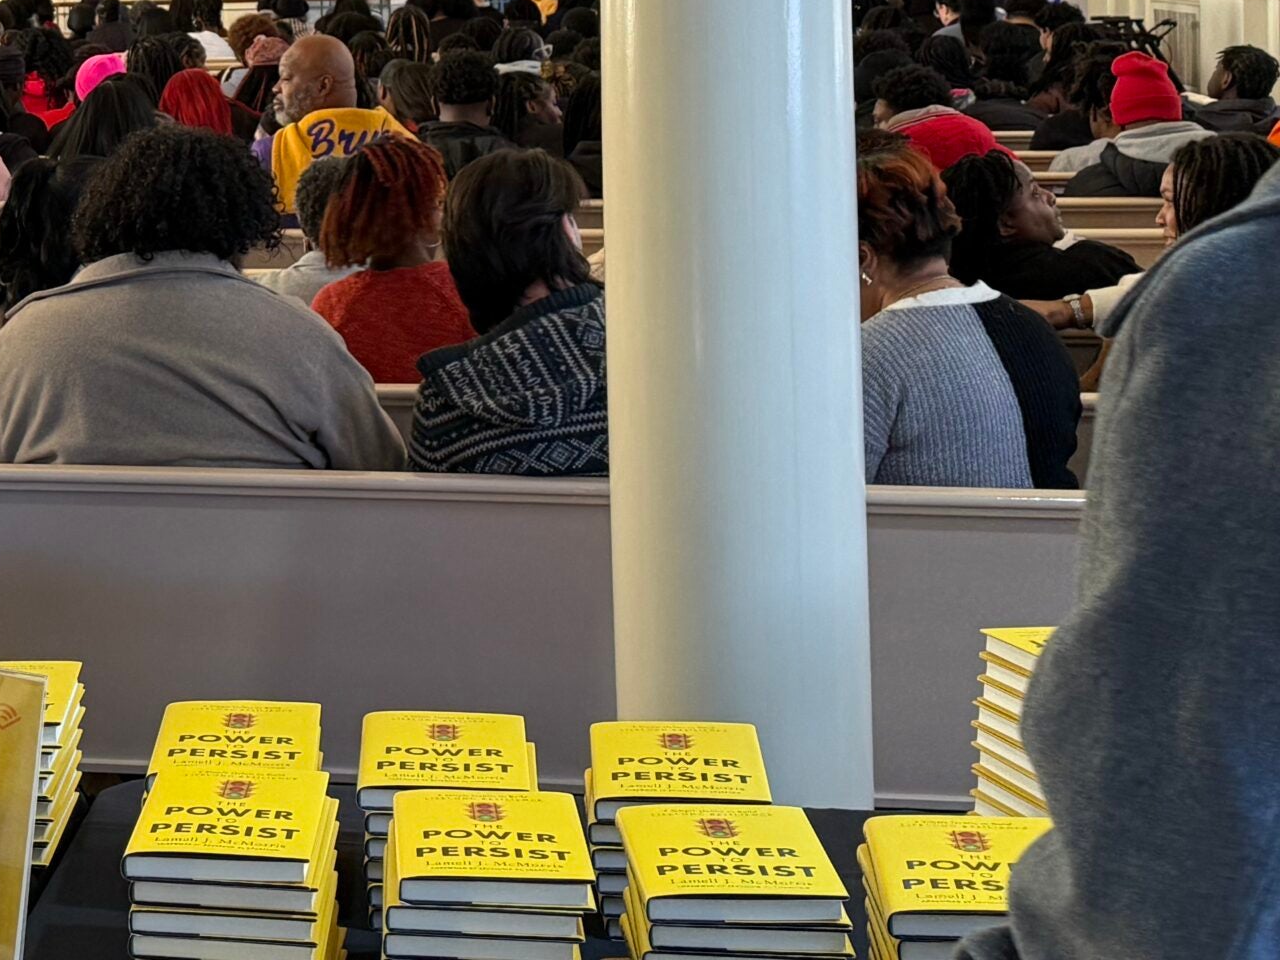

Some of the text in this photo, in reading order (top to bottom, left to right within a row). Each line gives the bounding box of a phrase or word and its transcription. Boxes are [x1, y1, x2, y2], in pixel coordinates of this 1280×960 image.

[178, 734, 295, 745] POWER
[168, 748, 302, 761] PERSIST
[386, 746, 504, 758] POWER
[376, 761, 514, 773] PERSIST
[618, 757, 742, 769] POWER
[611, 771, 753, 785] PERSIST
[164, 806, 294, 821] POWER
[150, 822, 301, 840] PERSIST
[422, 830, 558, 843] POWER
[416, 846, 572, 861] PERSIST
[658, 846, 801, 858] POWER
[656, 864, 817, 878] PERSIST
[902, 878, 1005, 891] PERS
